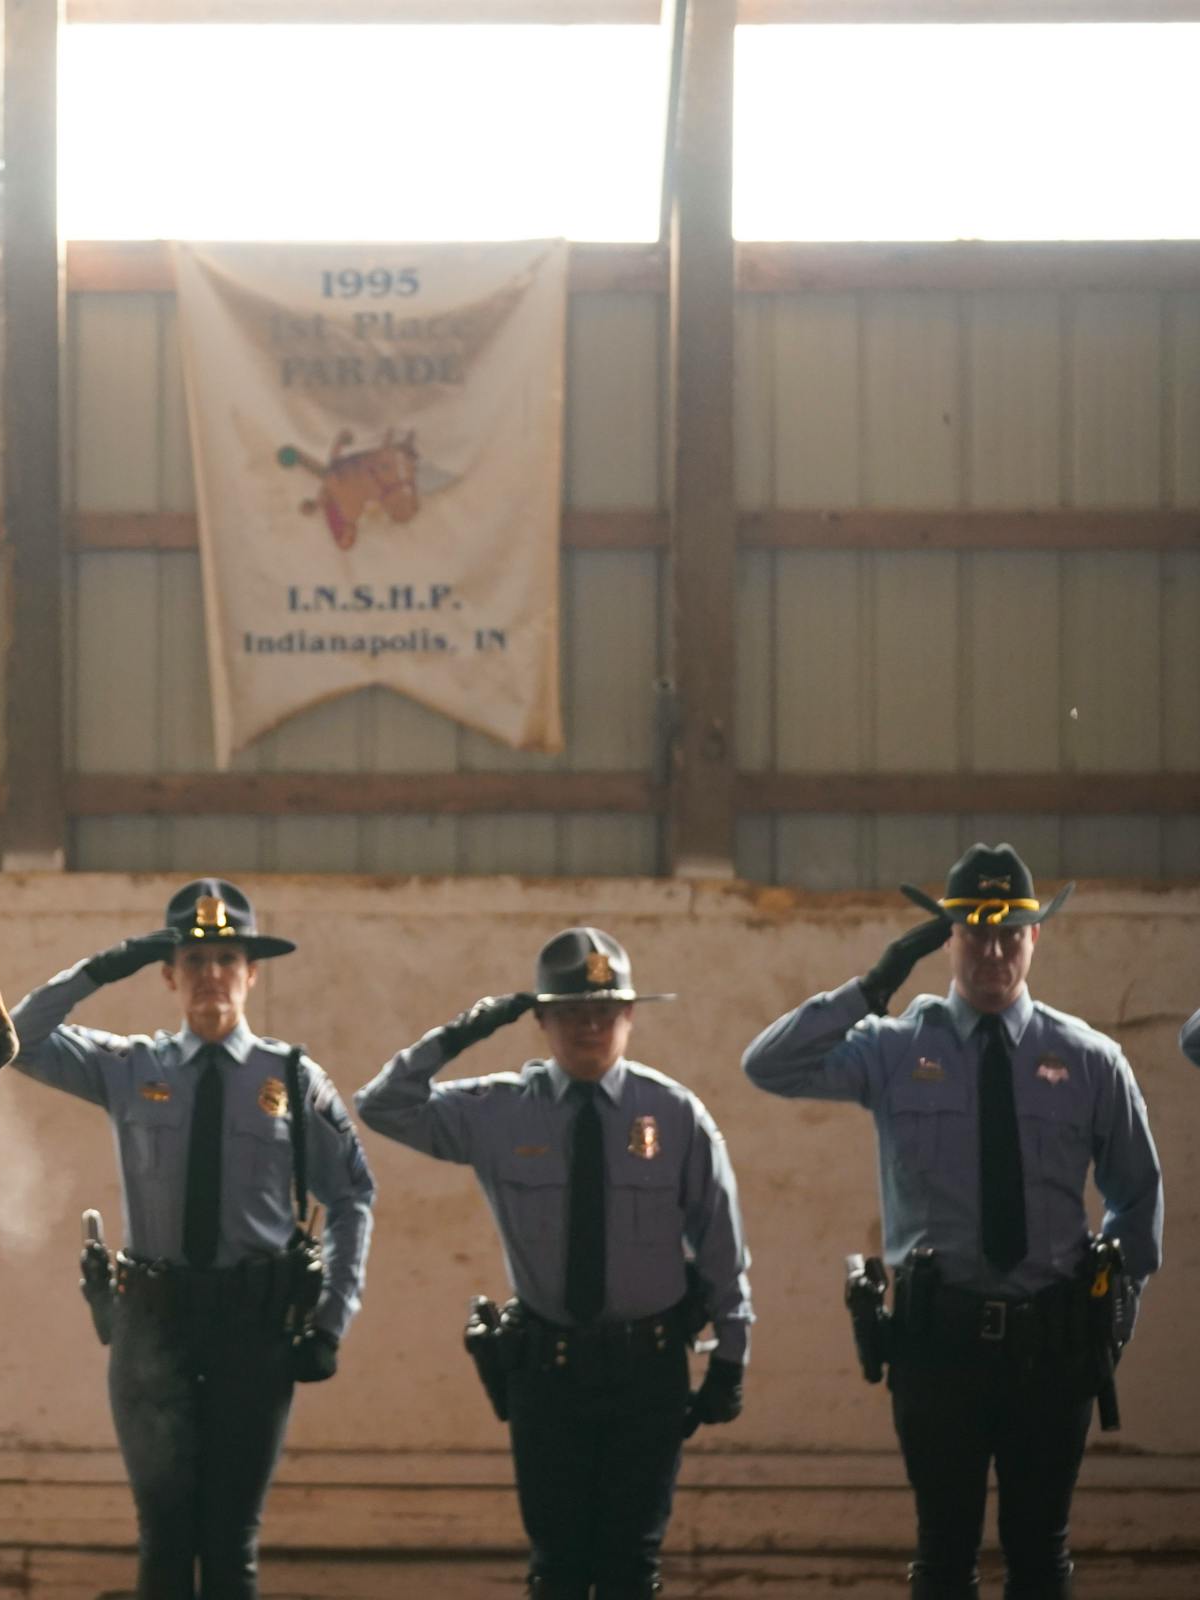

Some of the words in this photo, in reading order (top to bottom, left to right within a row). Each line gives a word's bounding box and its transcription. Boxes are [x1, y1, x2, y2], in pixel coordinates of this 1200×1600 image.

[321, 267, 421, 299] 1995
[281, 354, 465, 388] PARADE
[288, 585, 462, 611] I.N.S.H.P.
[474, 628, 507, 651] IN
